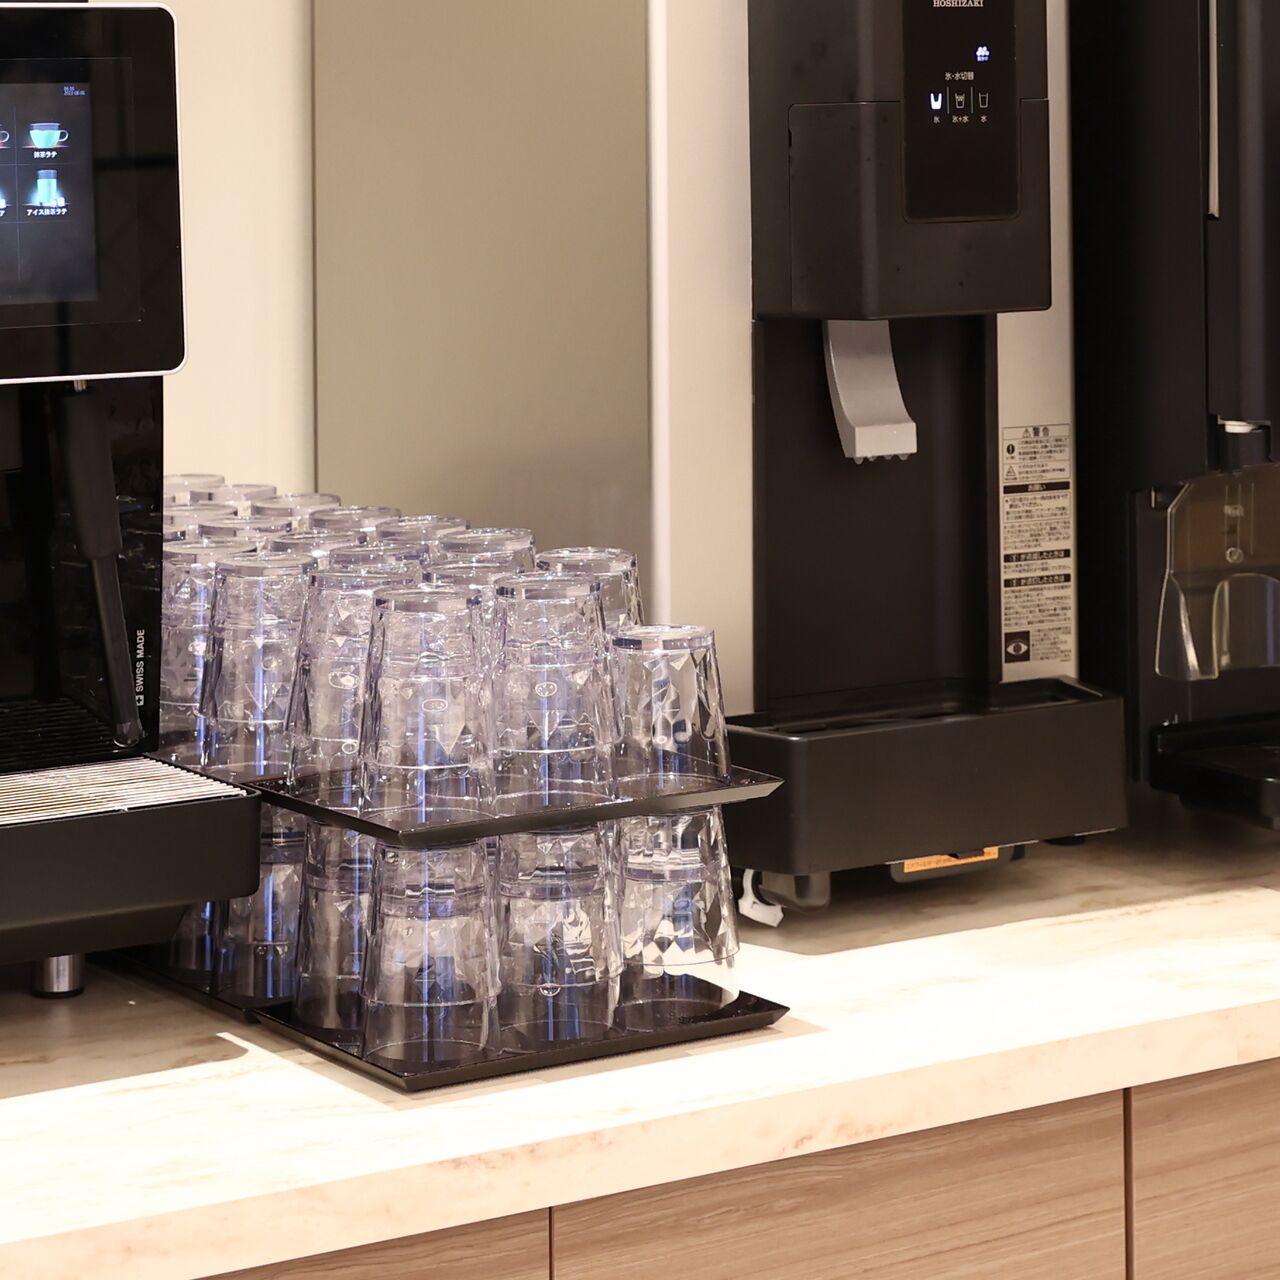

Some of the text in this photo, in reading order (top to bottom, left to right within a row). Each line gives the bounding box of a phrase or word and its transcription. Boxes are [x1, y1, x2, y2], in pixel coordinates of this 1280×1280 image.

[932, 0, 984, 8] HOSHIZAKI
[136, 629, 145, 692] SWISS MADE
